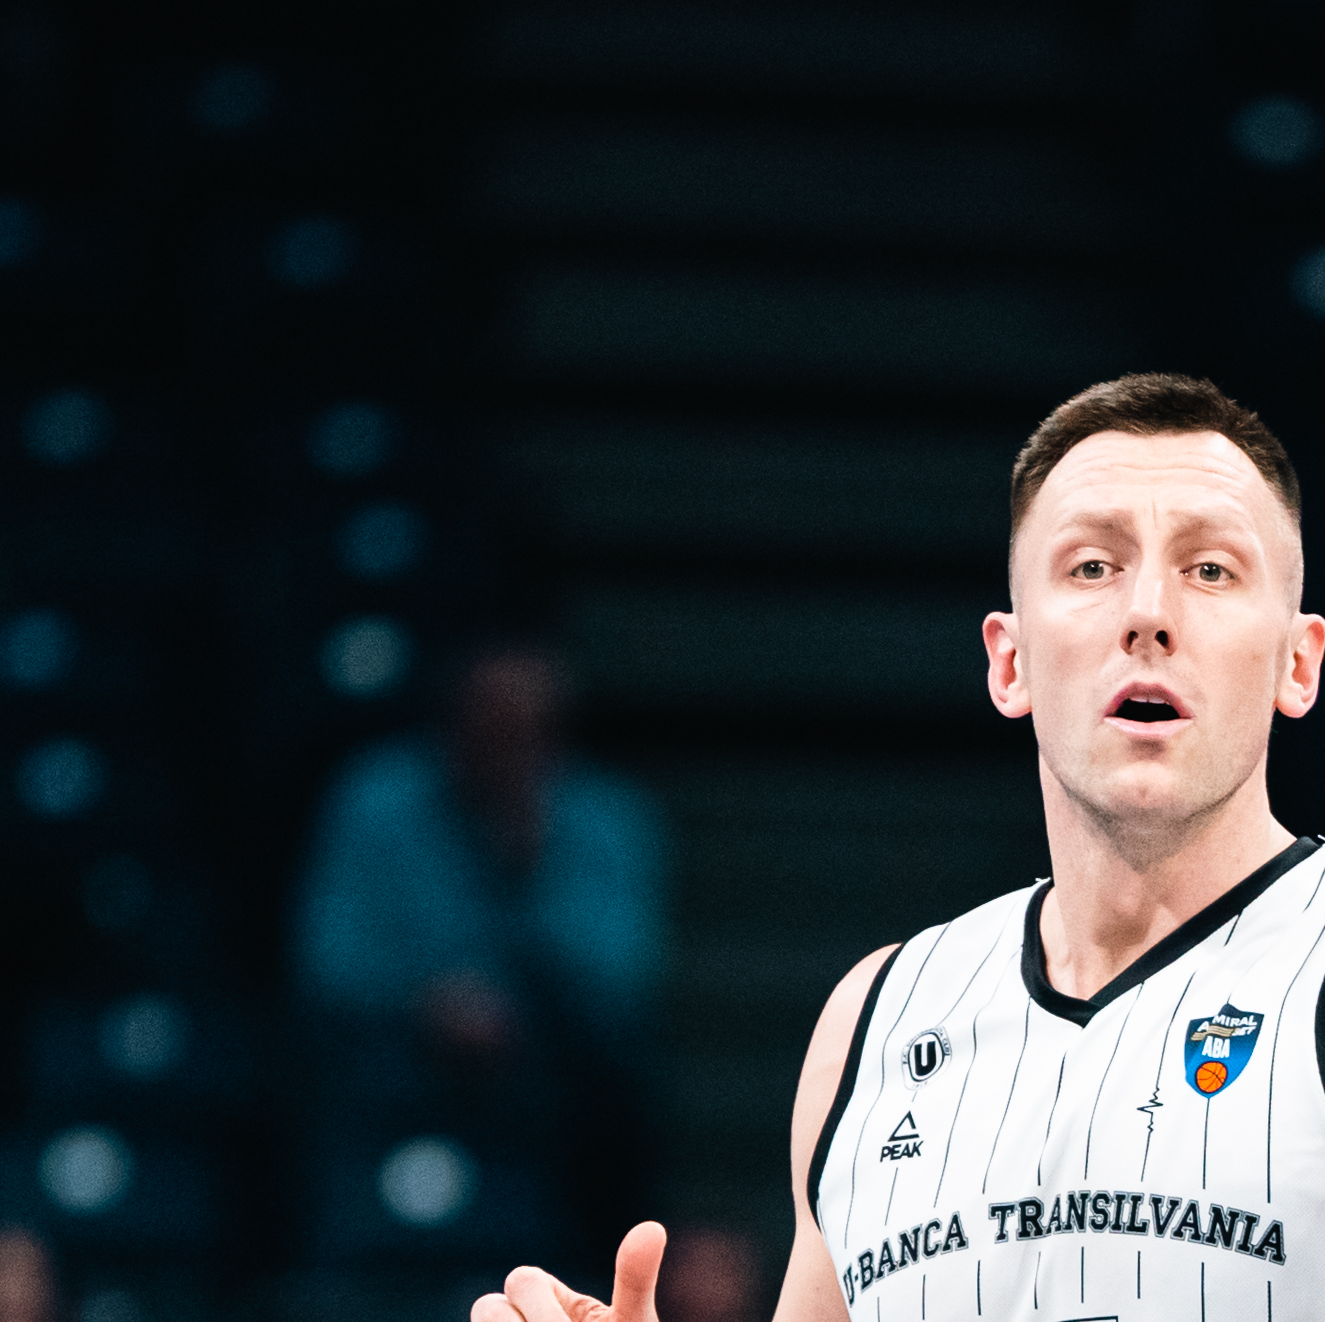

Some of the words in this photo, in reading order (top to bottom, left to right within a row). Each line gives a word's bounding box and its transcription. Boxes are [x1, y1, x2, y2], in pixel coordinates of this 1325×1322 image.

[1197, 1014, 1258, 1032] AMIRAL
[914, 1040, 937, 1077] U
[1201, 1036, 1231, 1058] ABA
[879, 1140, 925, 1163] PEAK
[842, 1211, 969, 1308] U-BANCA
[989, 1190, 1287, 1266] TRANSILVANIA
